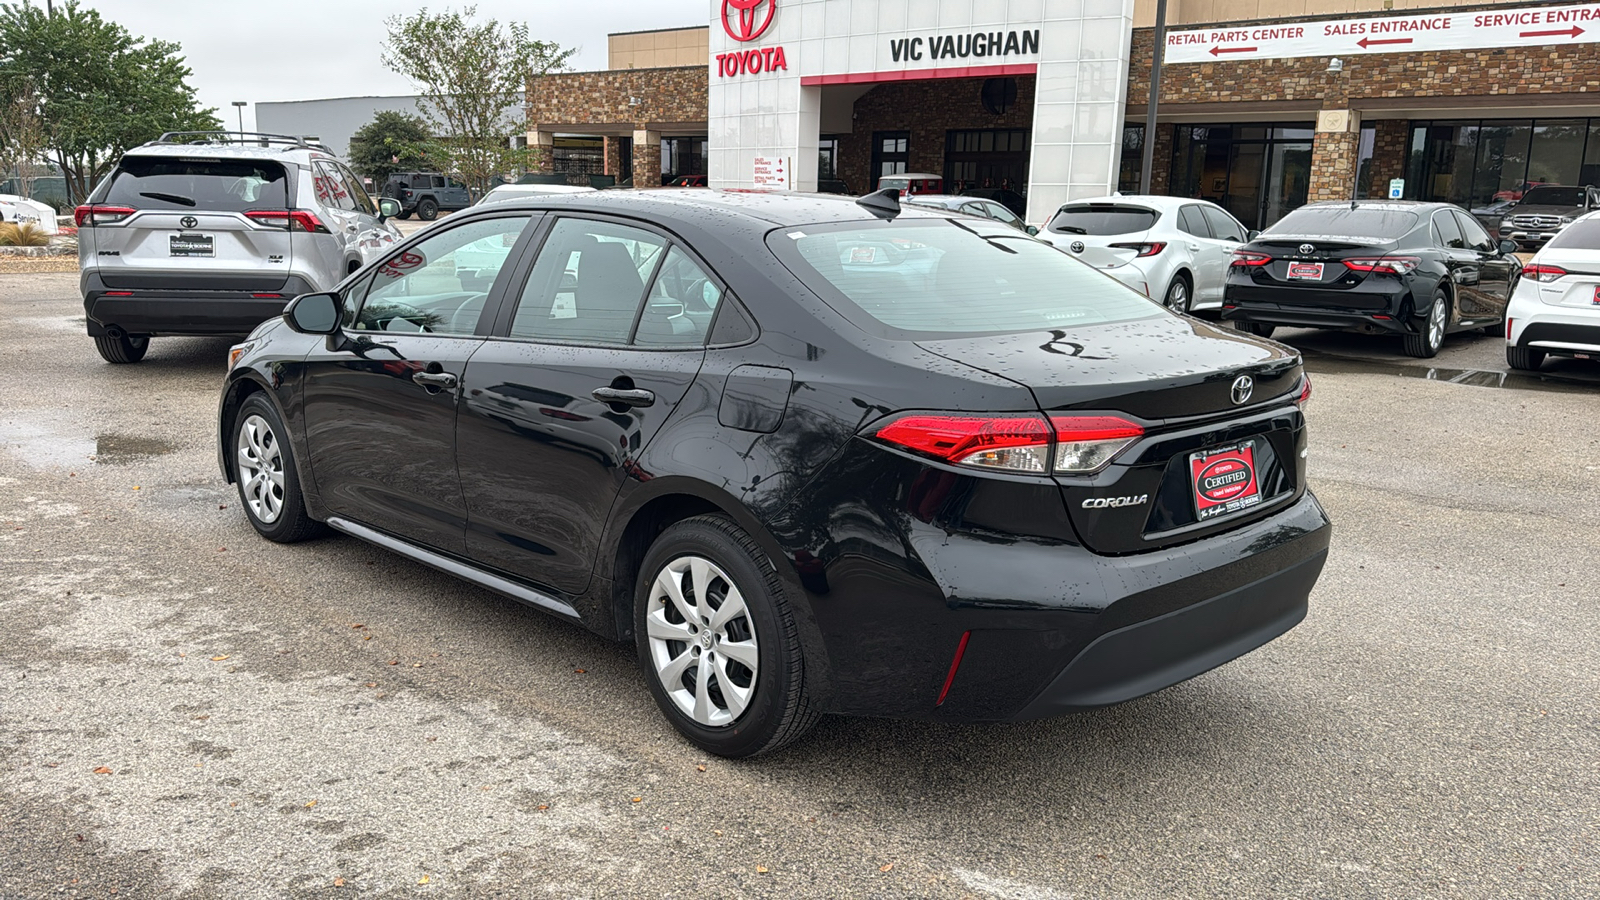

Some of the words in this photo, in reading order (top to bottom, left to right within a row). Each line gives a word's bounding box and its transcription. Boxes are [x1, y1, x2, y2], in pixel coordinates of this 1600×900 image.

[1323, 22, 1366, 36] SALES
[1370, 17, 1452, 34] ENTRANCE
[1474, 12, 1541, 28] SERVICE
[1168, 33, 1207, 45] RETAIL
[1211, 31, 1249, 43] PARTS
[1252, 27, 1304, 40] CENTER
[890, 37, 923, 62] VIC
[928, 29, 1040, 60] VAUGHAN
[715, 46, 788, 78] TOYOTA
[18, 213, 36, 224] Service
[1213, 488, 1224, 497] Used
[1224, 486, 1242, 494] Vehicles
[1081, 493, 1149, 509] COROLLA
[1226, 502, 1240, 510] TOYOTA
